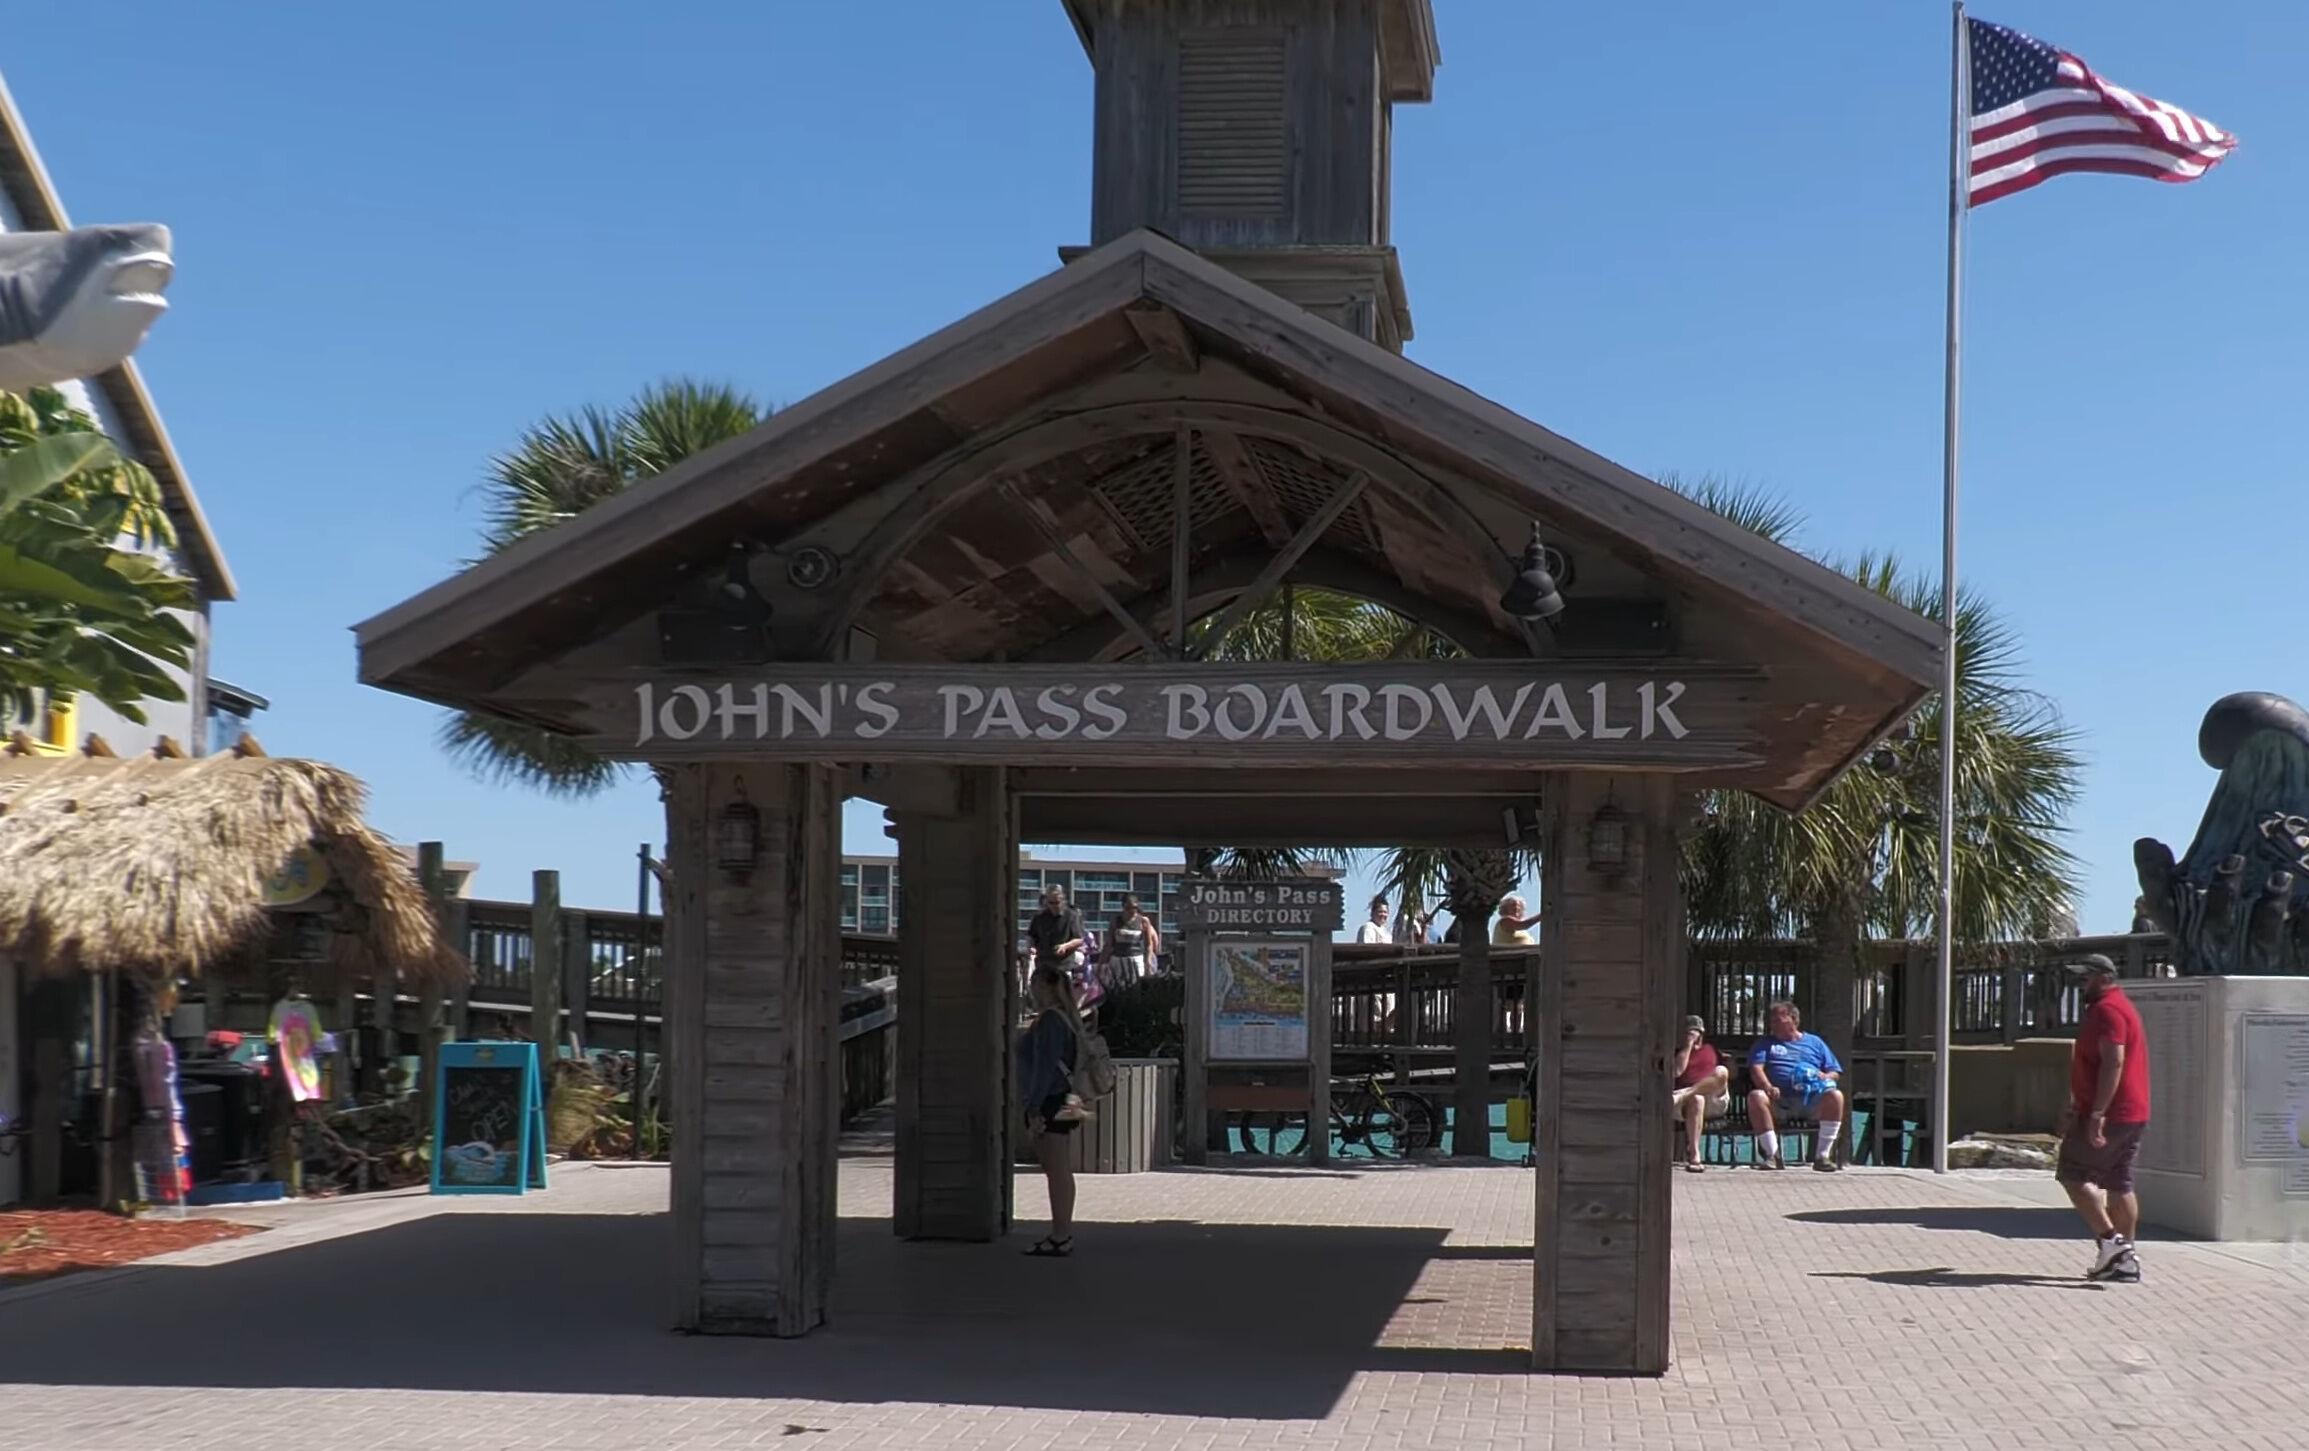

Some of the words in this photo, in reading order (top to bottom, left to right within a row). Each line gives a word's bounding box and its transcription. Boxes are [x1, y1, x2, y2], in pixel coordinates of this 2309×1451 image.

[634, 682, 900, 748] JOHN'S
[937, 683, 1128, 740] PASS
[1159, 681, 1690, 741] BOARDWALK
[1190, 885, 1266, 904] John's
[1278, 886, 1331, 904] Pass
[1207, 909, 1313, 924] DIRECTORY
